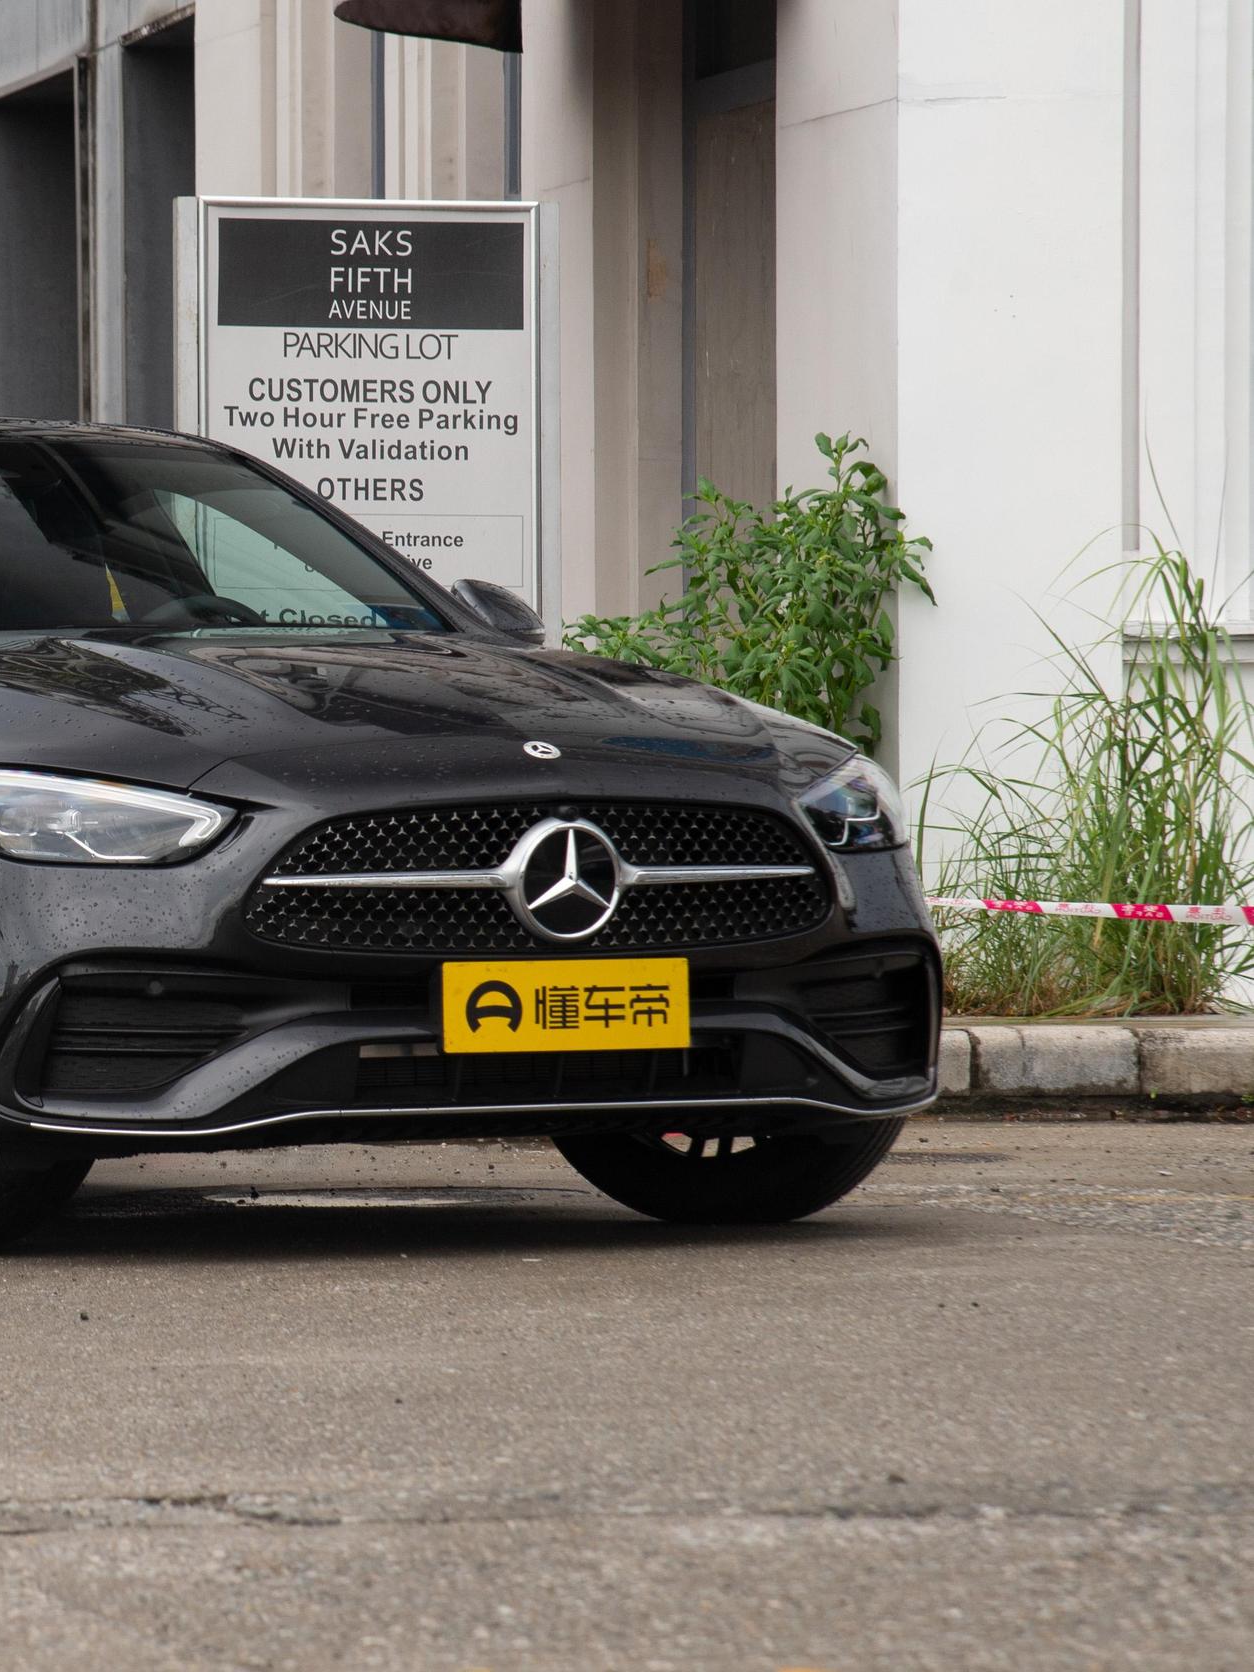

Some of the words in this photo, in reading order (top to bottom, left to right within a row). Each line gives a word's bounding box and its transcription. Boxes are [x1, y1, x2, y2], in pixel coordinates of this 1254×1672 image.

[330, 229, 413, 257] SAKS
[330, 266, 412, 294] FIFTH
[328, 299, 412, 320] AVENUE
[283, 332, 399, 360] PARKING
[405, 333, 459, 360] LOT
[248, 377, 415, 404] CUSTOMERS
[422, 379, 493, 405] ONLY
[224, 405, 275, 428] Two
[283, 406, 346, 429] Hour
[353, 408, 410, 429] Free
[418, 408, 518, 436] Parking
[272, 437, 330, 460] With
[337, 438, 469, 461] Validation
[317, 477, 424, 502] OTHERS
[382, 530, 464, 548] Entrance
[279, 607, 377, 627] Closed
[534, 983, 670, 1030] 懂车帝
